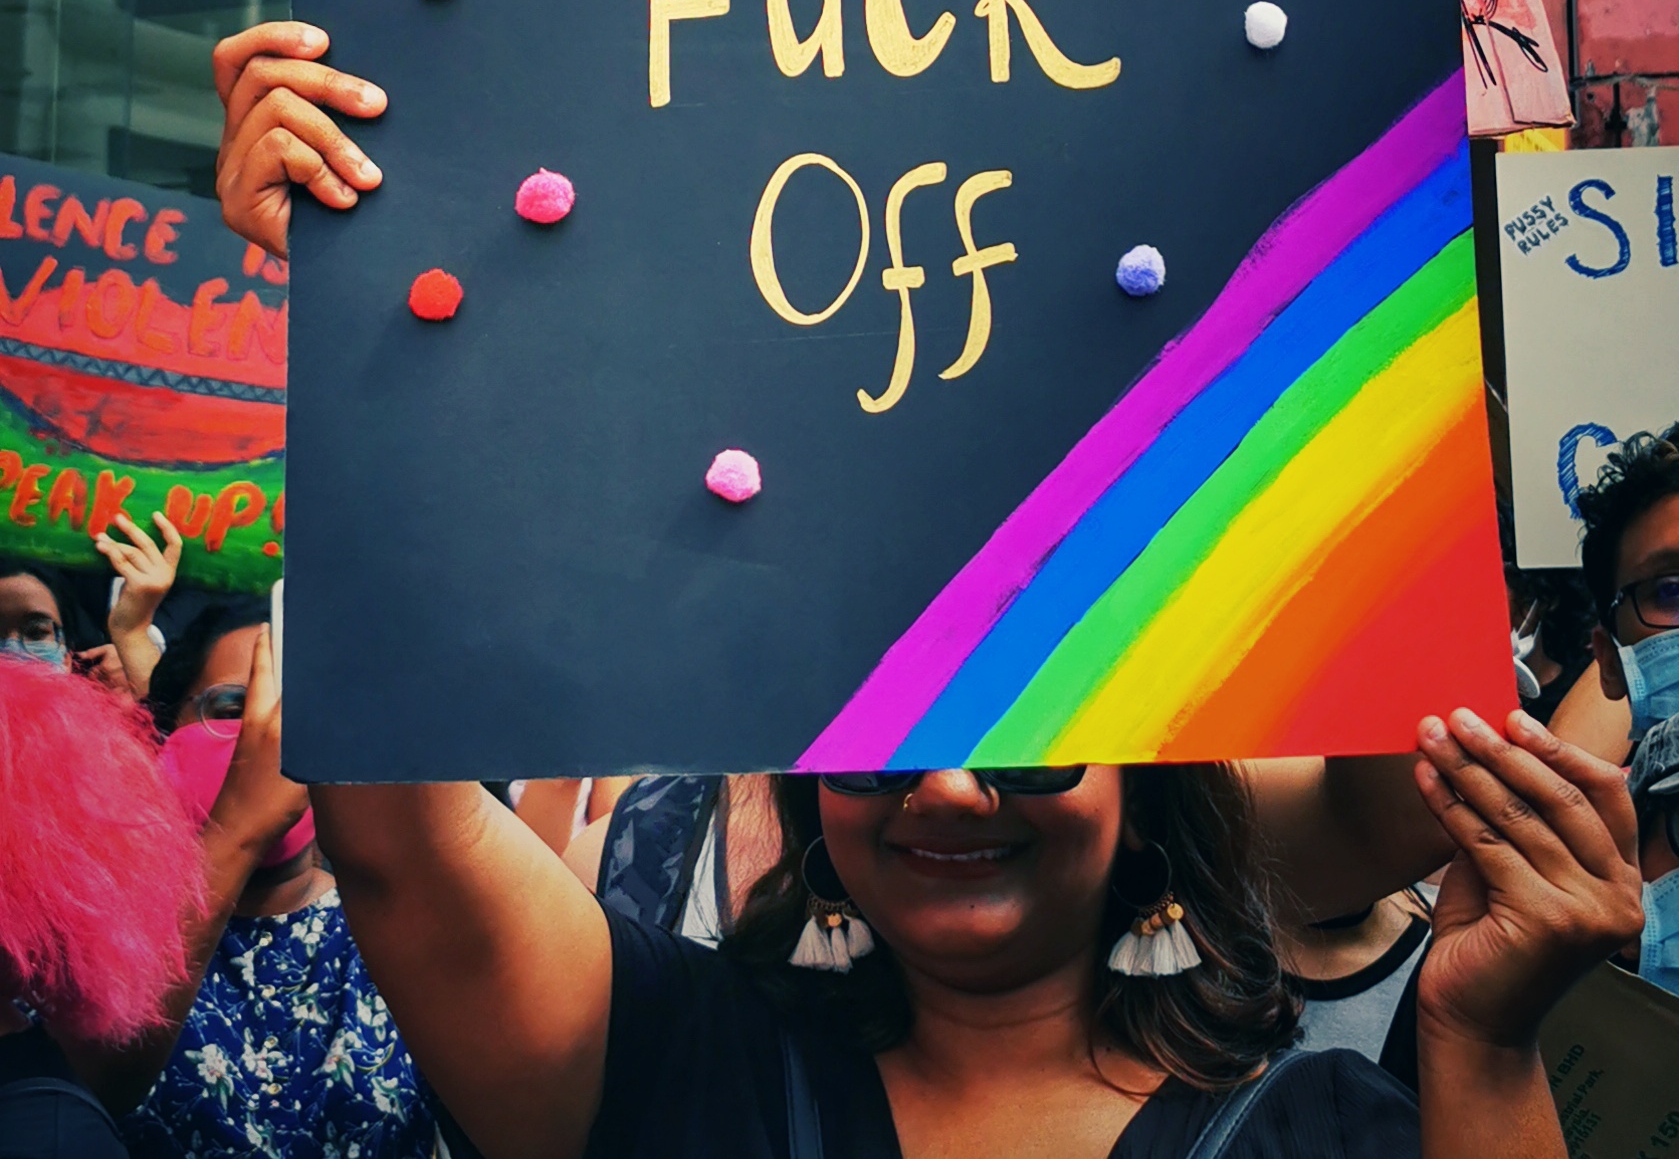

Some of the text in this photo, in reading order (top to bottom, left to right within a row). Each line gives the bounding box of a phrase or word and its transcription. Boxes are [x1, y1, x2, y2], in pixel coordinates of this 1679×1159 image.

[1504, 195, 1555, 241] PUSSY
[1517, 213, 1569, 256] RULES
[750, 152, 1019, 413] Off
[1556, 1043, 1585, 1076] BHD
